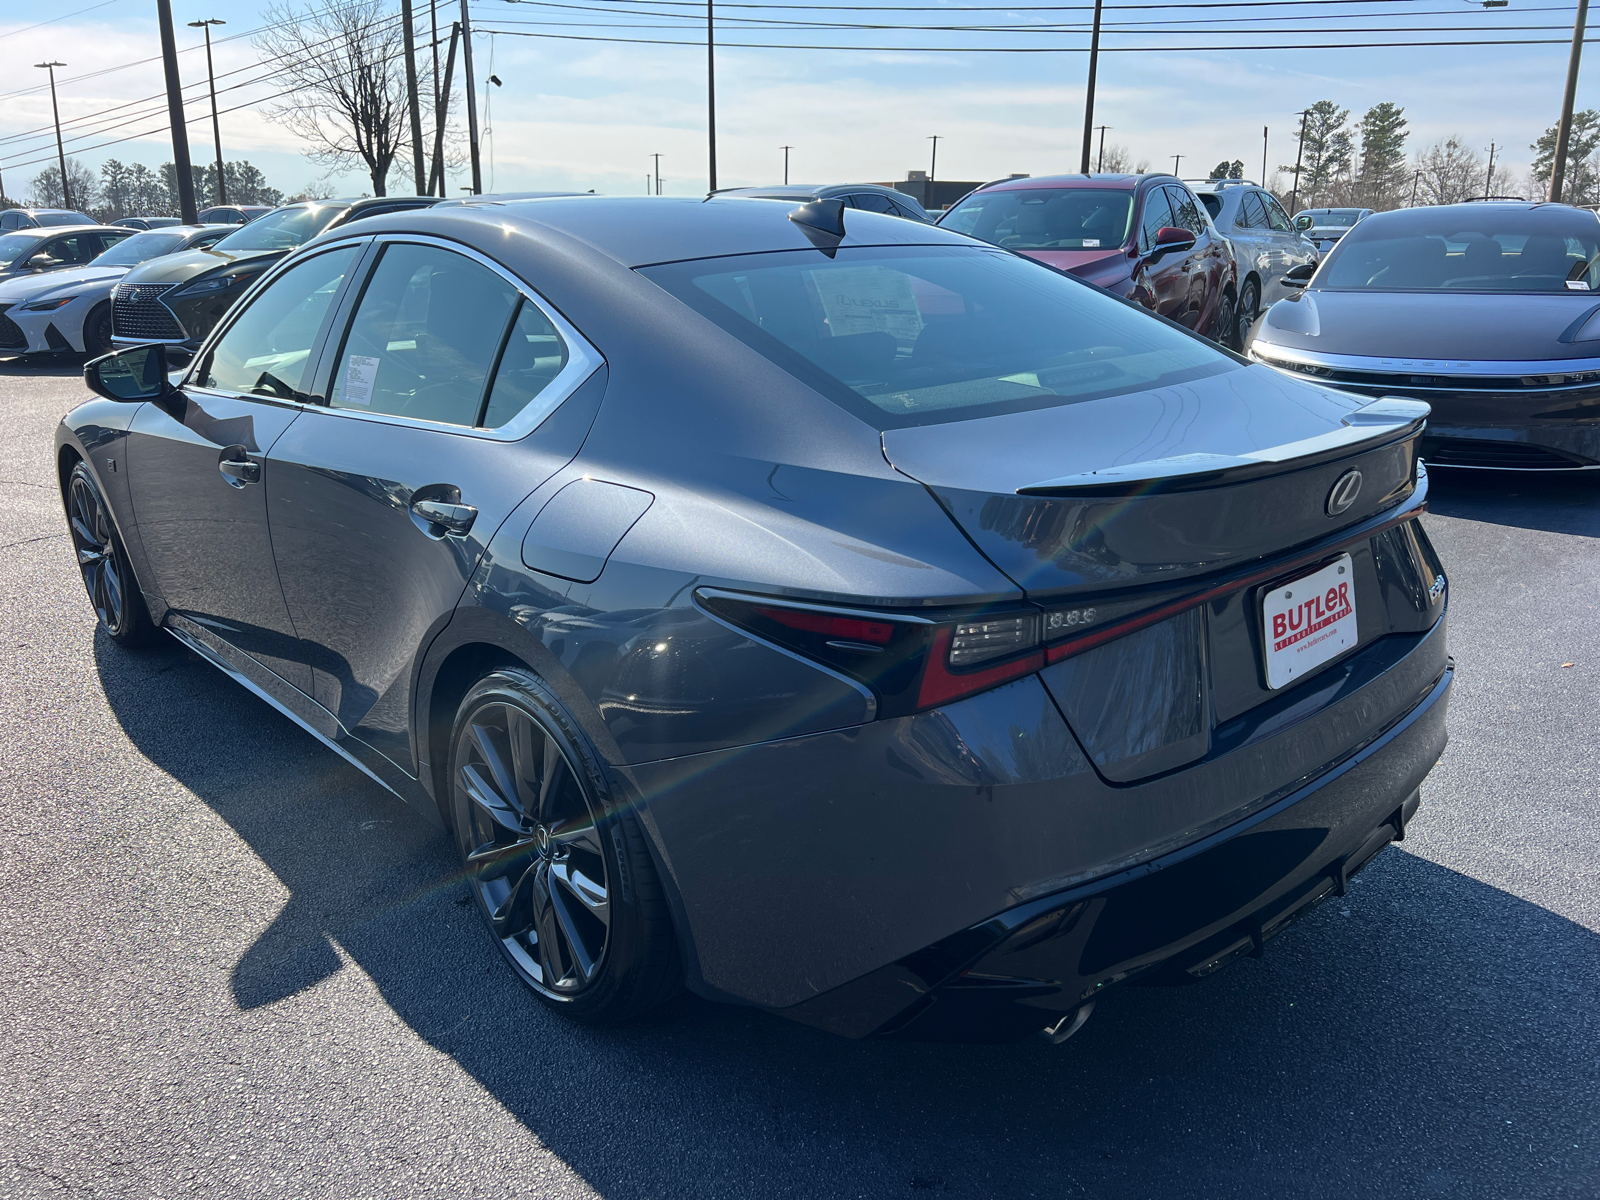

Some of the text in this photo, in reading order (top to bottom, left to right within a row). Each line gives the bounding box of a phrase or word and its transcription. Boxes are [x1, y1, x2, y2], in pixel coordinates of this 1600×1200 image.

[852, 298, 900, 309] LEXUS
[1379, 359, 1471, 368] LUCID
[1296, 628, 1338, 653] www.butlercars.com
[547, 702, 612, 817] POTENZA
